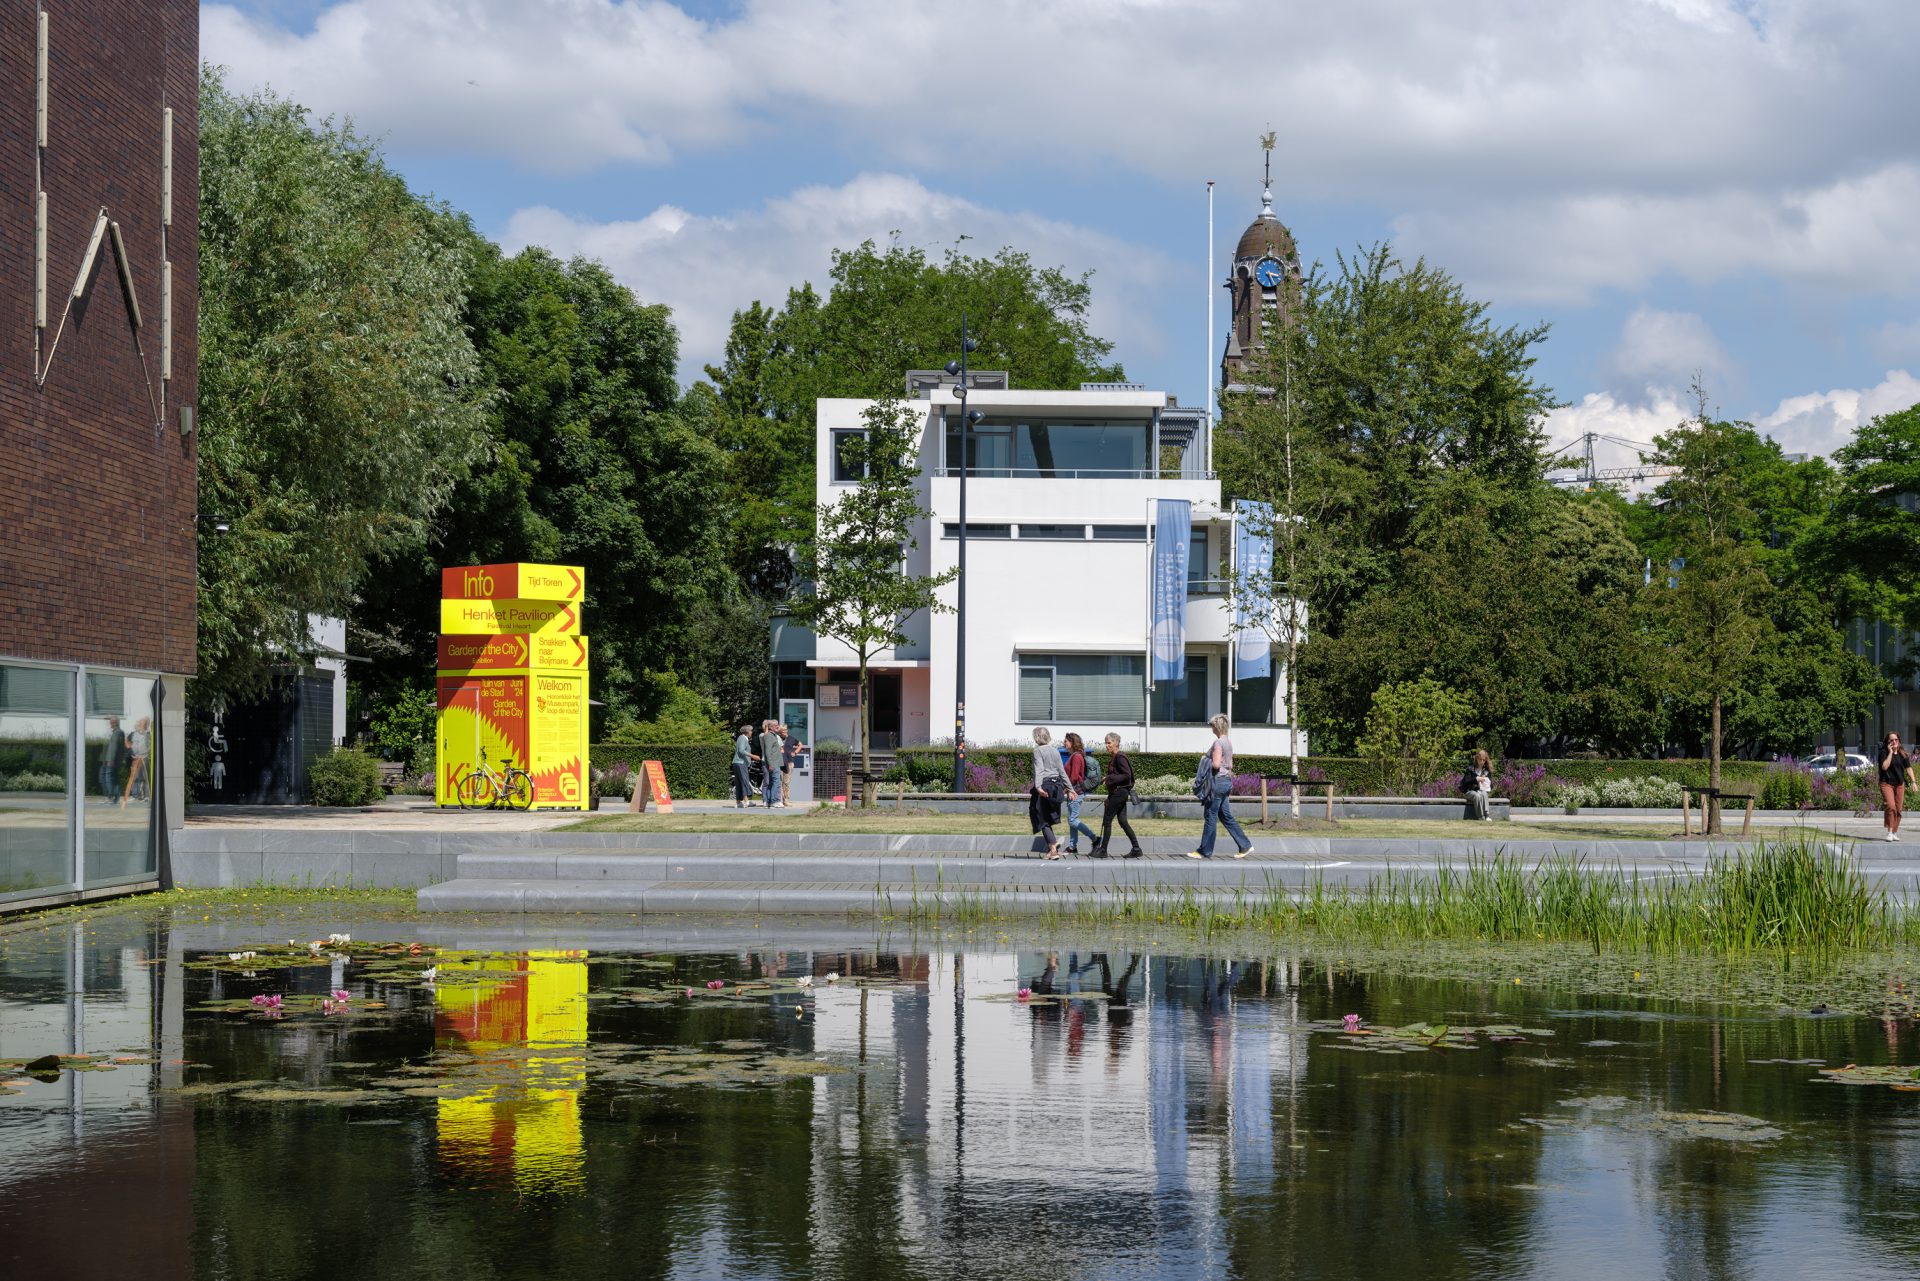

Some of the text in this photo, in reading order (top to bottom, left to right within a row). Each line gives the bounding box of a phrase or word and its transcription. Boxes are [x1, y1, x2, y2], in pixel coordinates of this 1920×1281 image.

[464, 569, 495, 597] Info
[528, 576, 562, 588] Tijd Toren
[1165, 553, 1174, 615] MUSEUM
[463, 608, 556, 621] Henket Pavilion
[538, 637, 567, 647] Snakken
[448, 644, 478, 656] Garden
[488, 643, 501, 655] the
[502, 642, 519, 657] City
[539, 656, 569, 667] Boijmans
[510, 679, 523, 687] Juni
[538, 679, 572, 691] Welkom
[481, 688, 504, 696] de Stad
[493, 699, 516, 708] Garden
[493, 708, 523, 718] of the City
